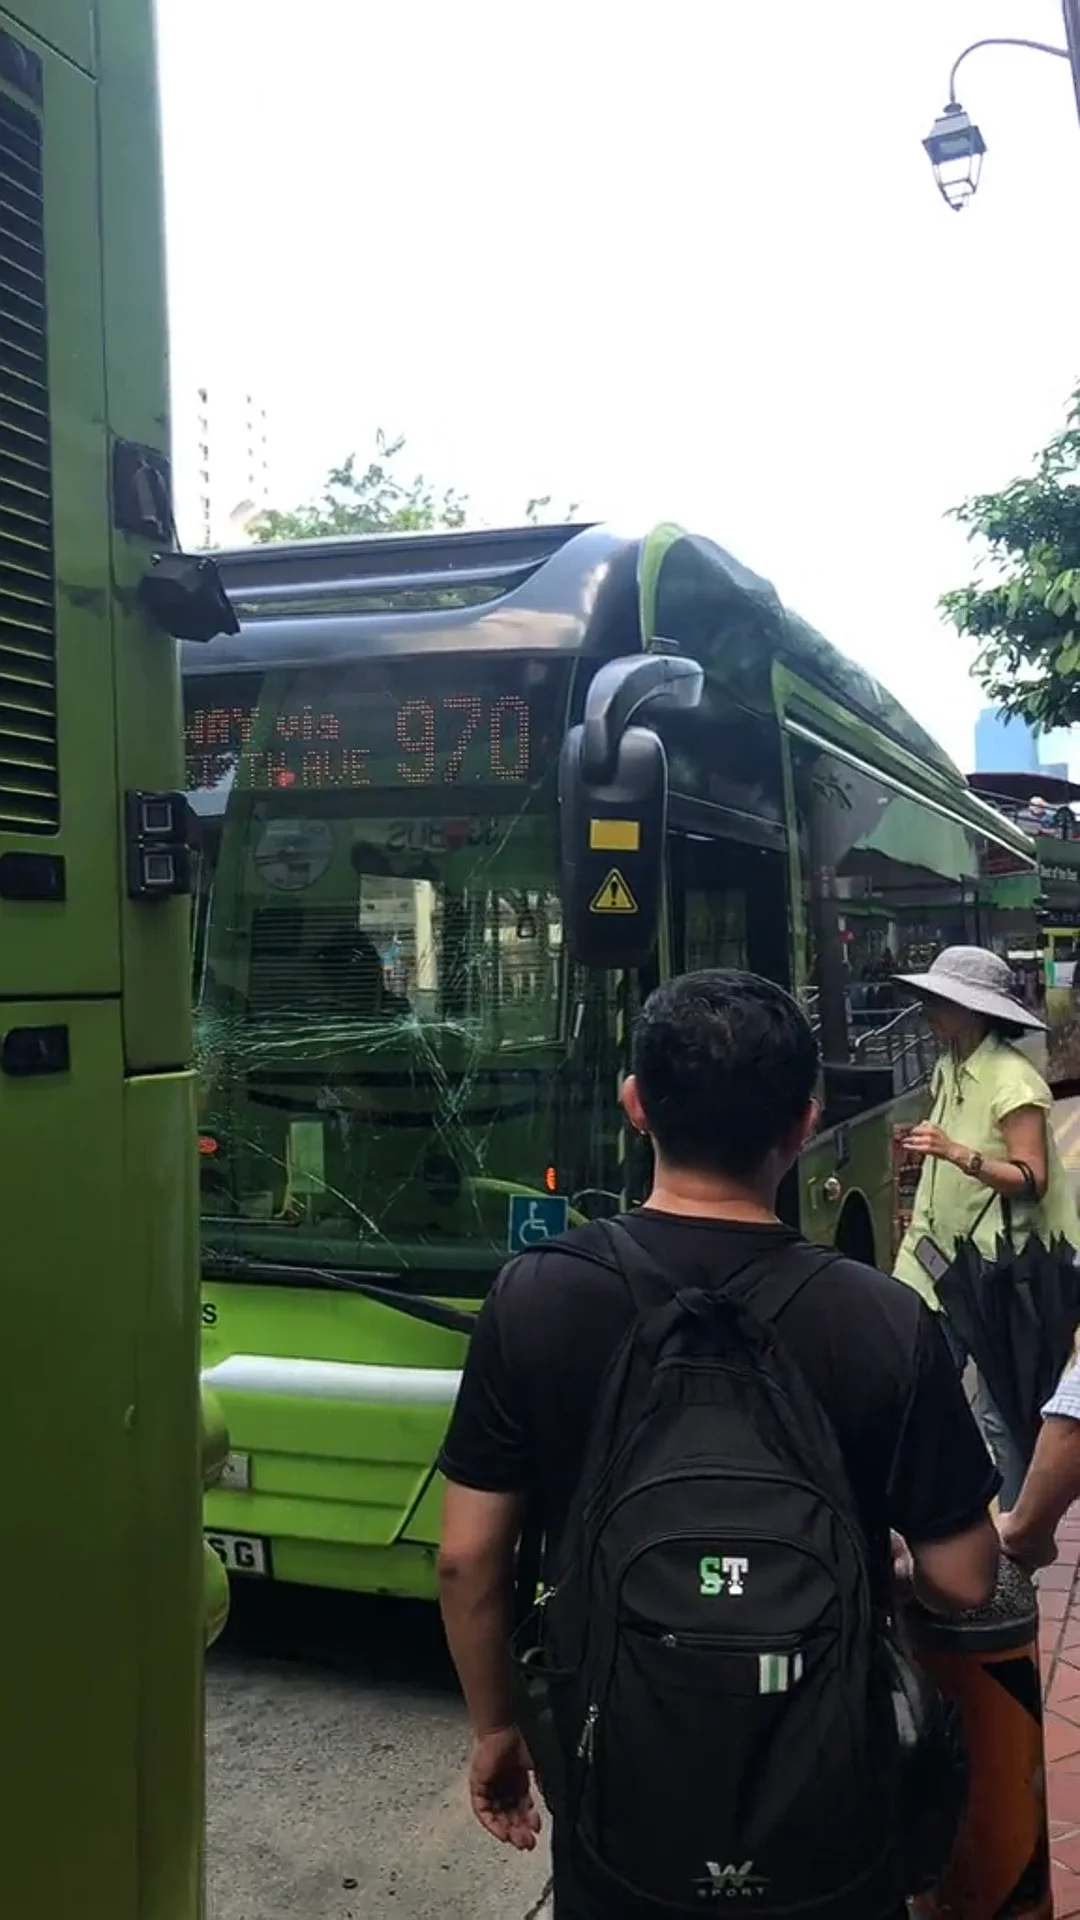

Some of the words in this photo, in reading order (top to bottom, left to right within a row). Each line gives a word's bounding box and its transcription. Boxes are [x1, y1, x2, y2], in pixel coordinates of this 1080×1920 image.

[276, 704, 339, 741] via
[397, 694, 529, 783] 970
[302, 749, 371, 786] AVE
[699, 1556, 749, 1595] ST
